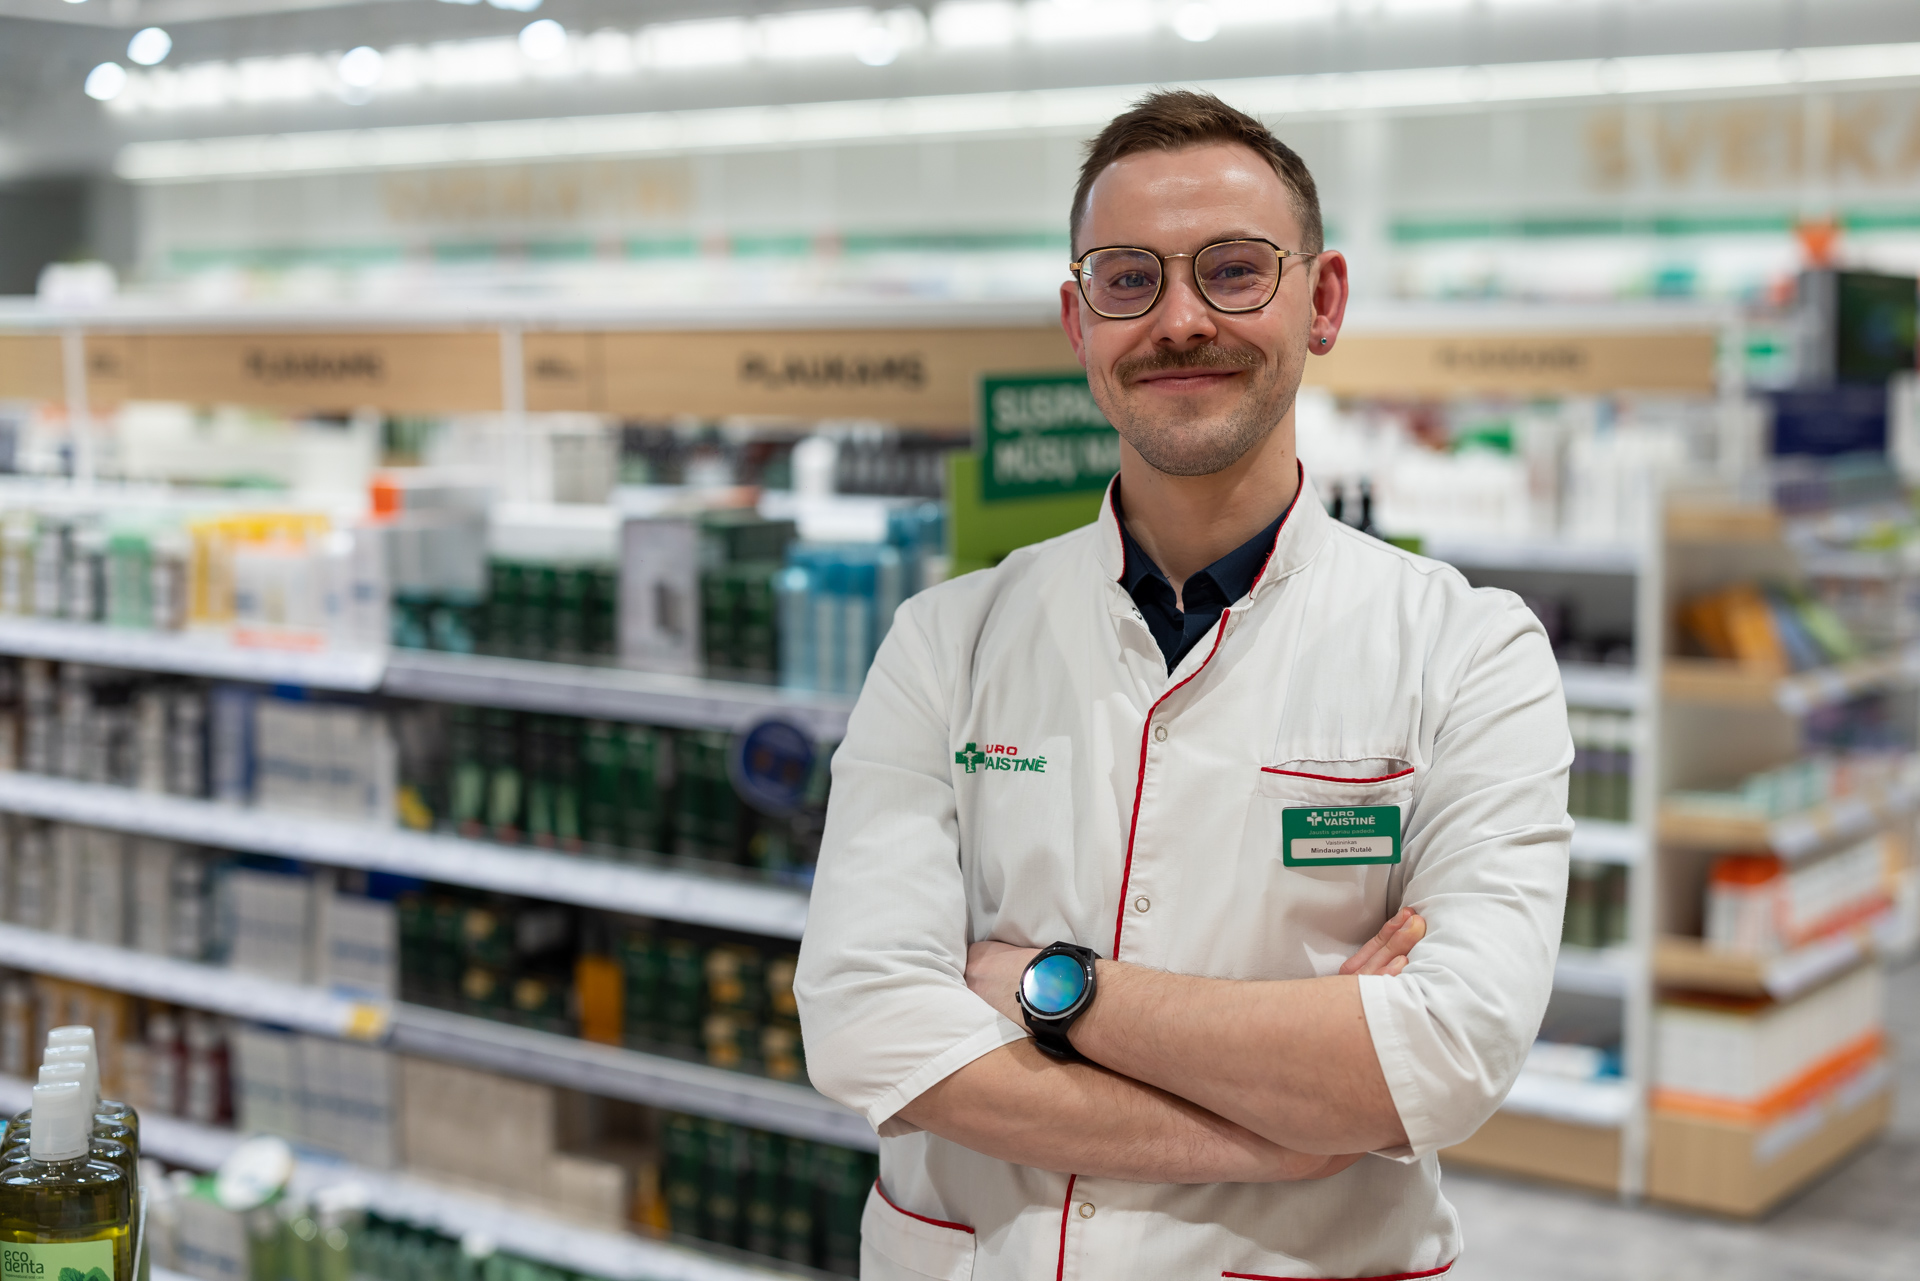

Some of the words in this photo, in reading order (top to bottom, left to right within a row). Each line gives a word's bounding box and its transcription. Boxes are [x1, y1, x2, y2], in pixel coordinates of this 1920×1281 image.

[1323, 815, 1376, 826] VAISTINĖ
[4, 1250, 29, 1262] eco
[4, 1258, 44, 1274] denta
